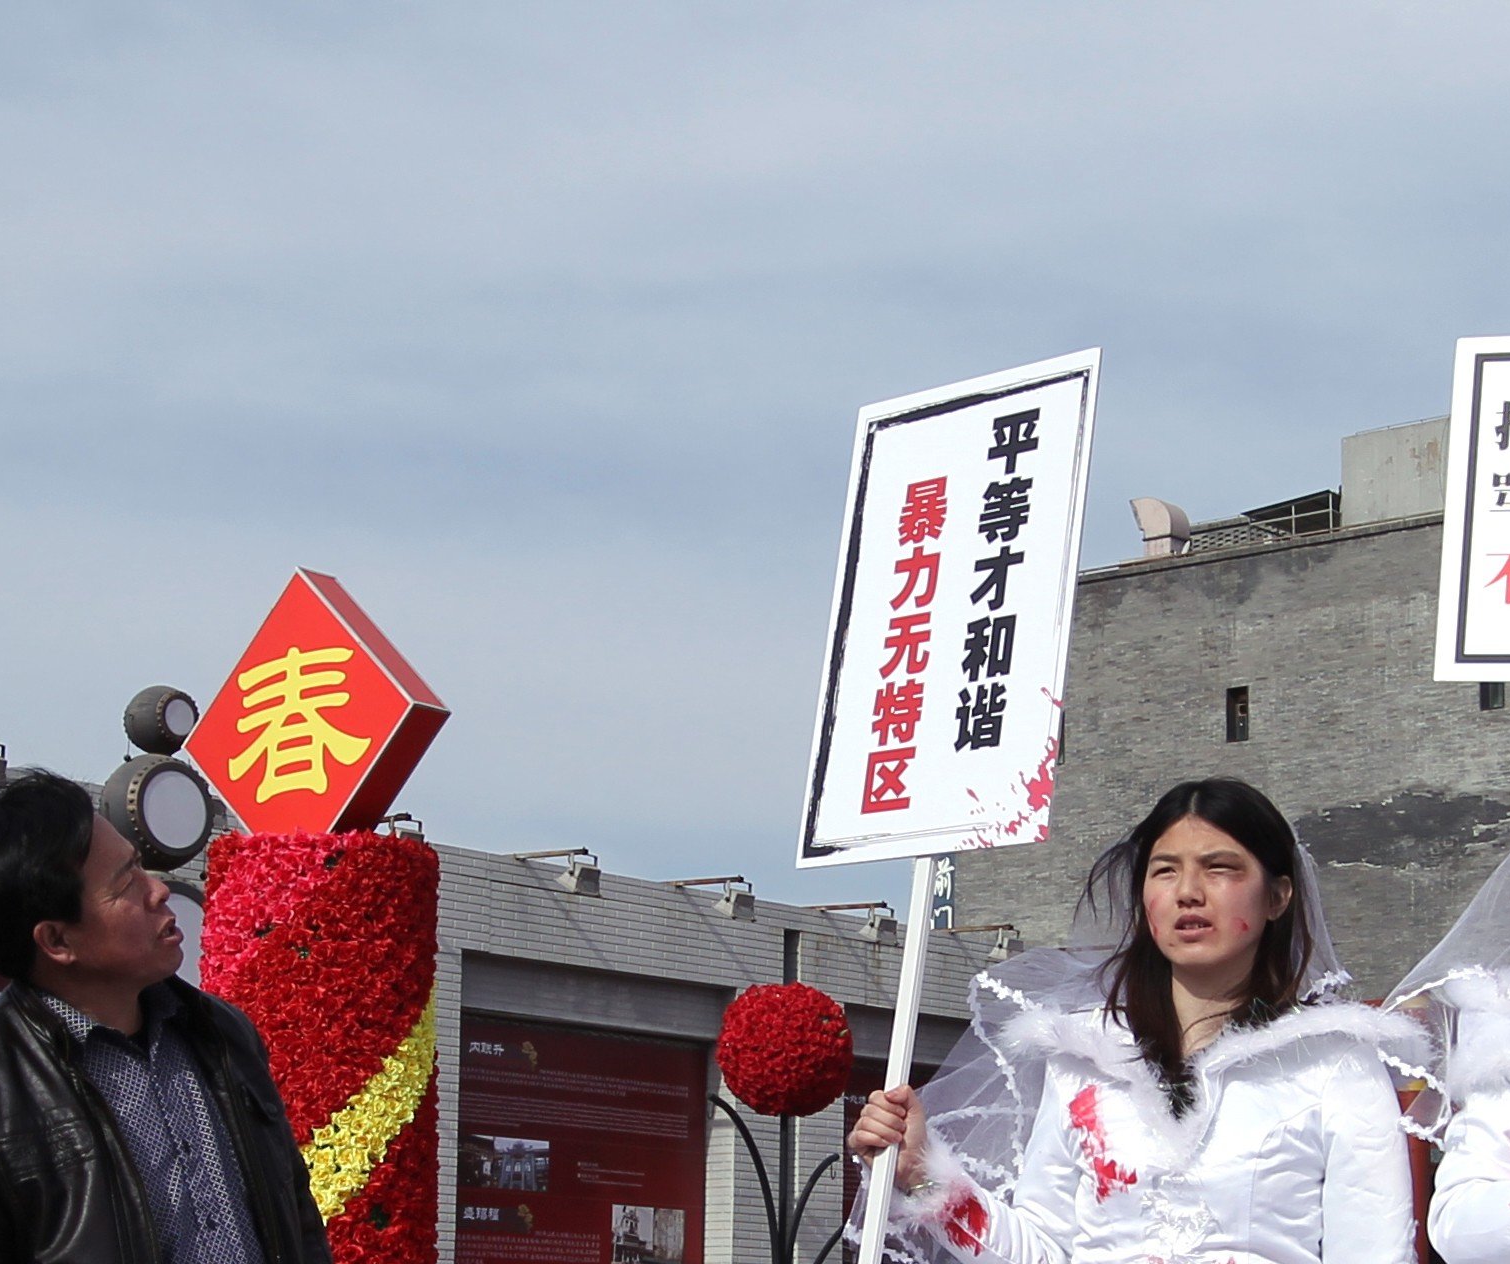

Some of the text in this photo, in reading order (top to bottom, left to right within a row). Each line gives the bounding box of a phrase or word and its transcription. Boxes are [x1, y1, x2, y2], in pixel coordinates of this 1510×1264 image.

[228, 645, 372, 804] 春
[860, 476, 949, 815] 暴力无特区
[953, 407, 1042, 752] 平等才和谐
